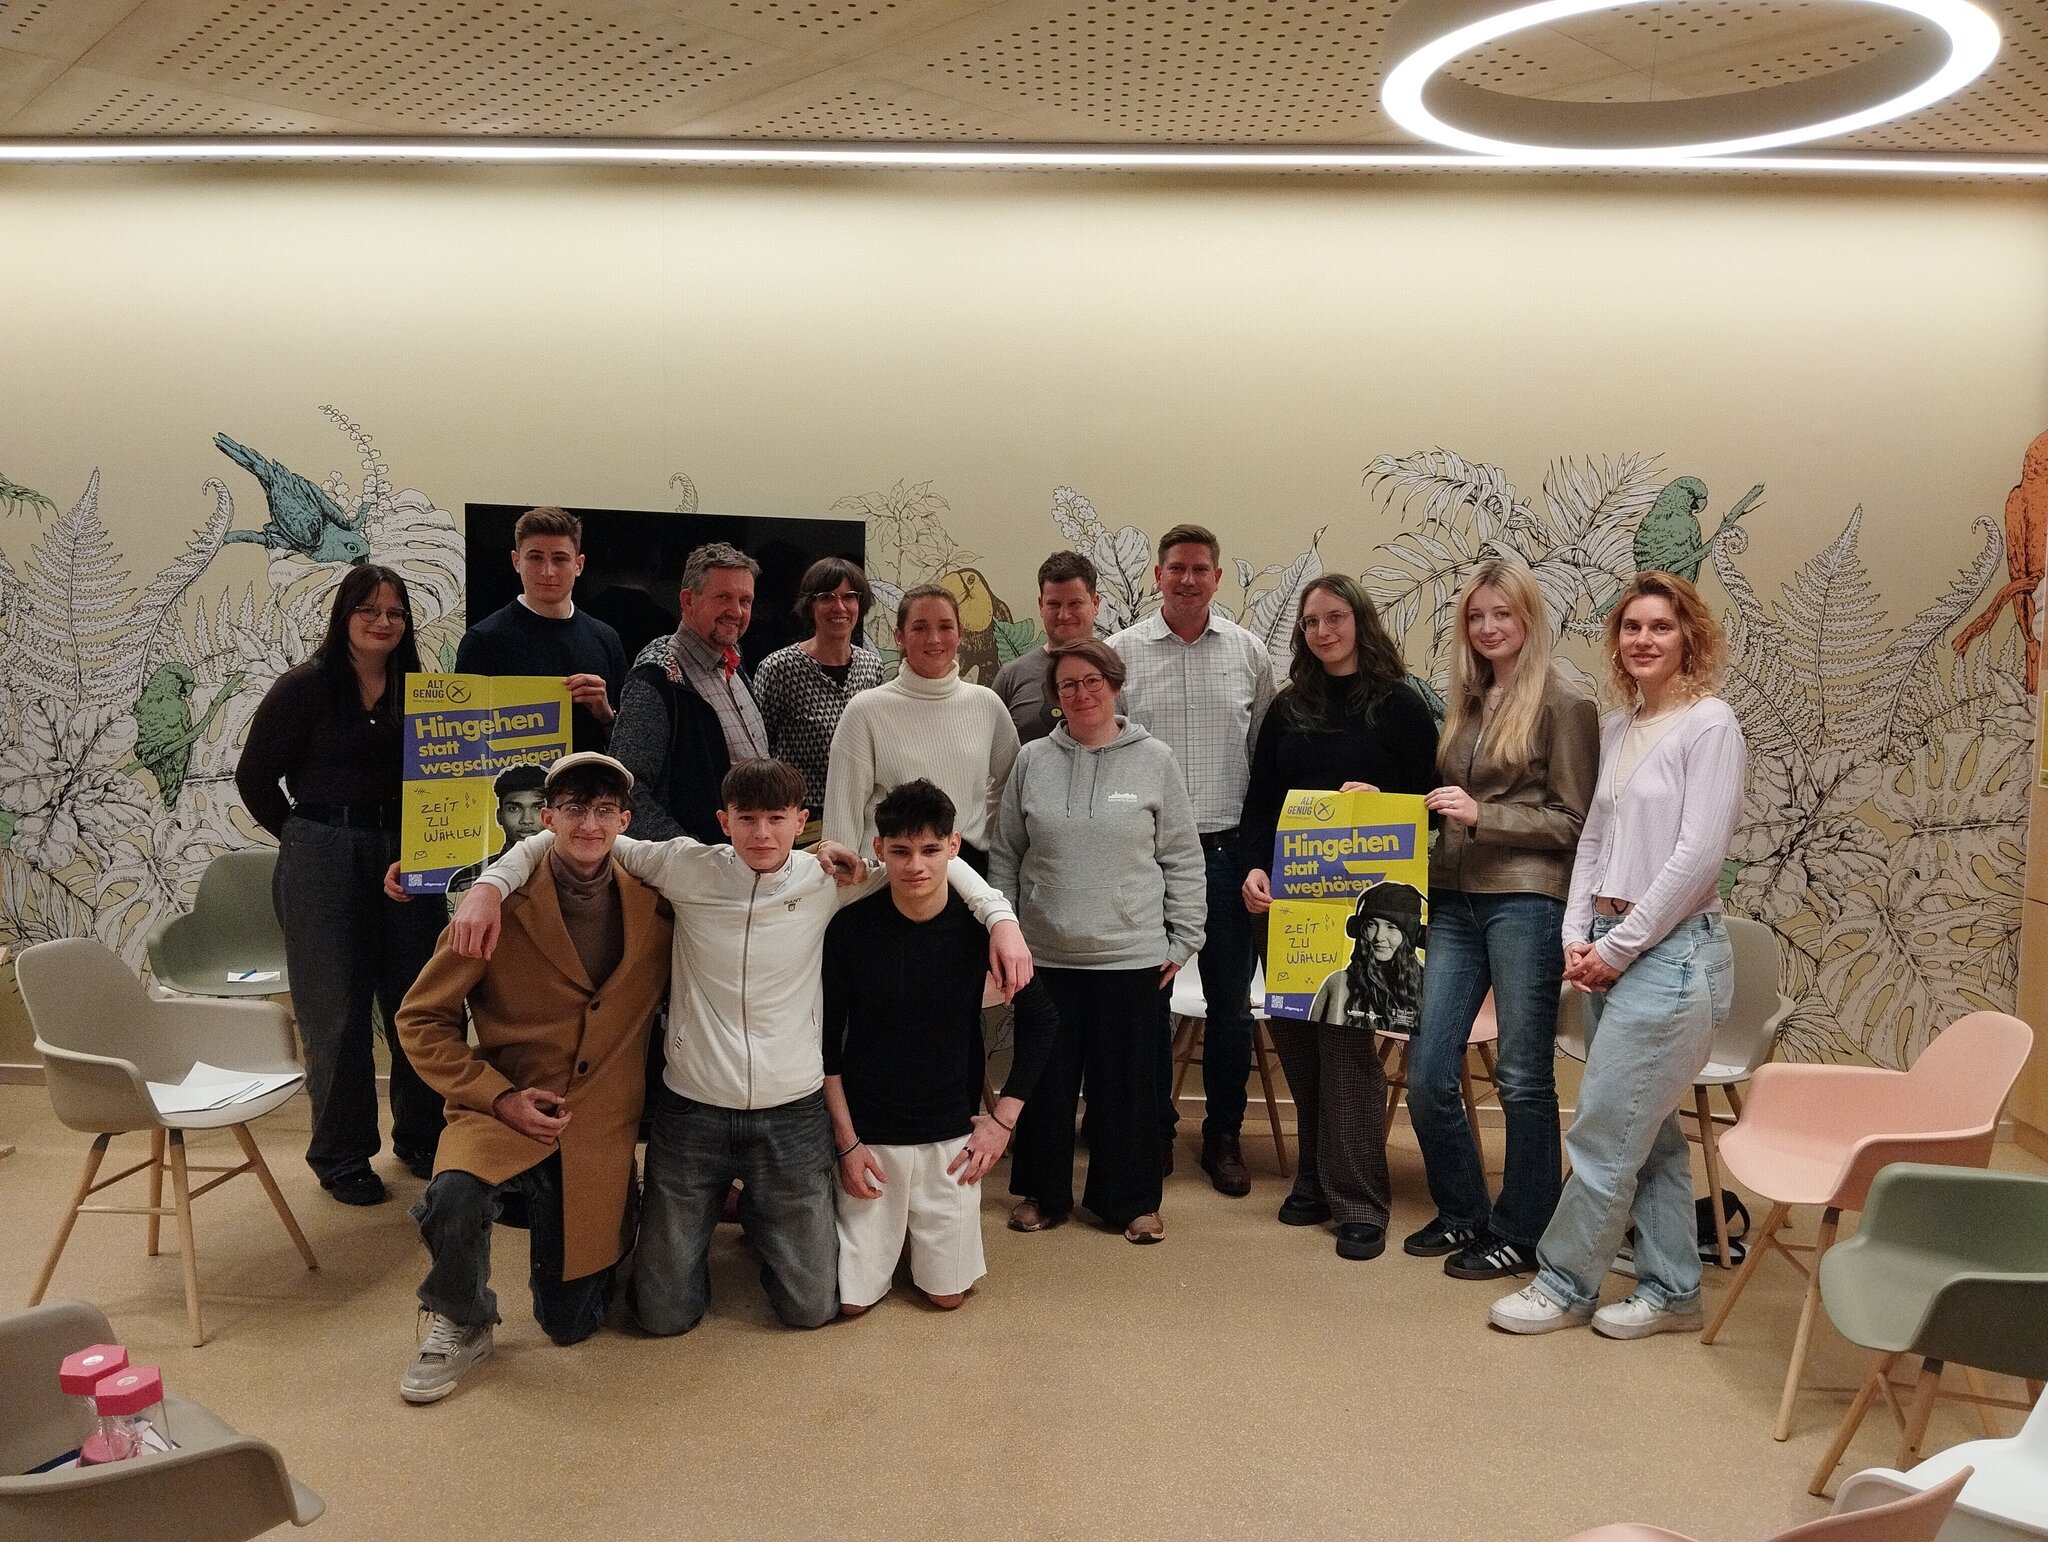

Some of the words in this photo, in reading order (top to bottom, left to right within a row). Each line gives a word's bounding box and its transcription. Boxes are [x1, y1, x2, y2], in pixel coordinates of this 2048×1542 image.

[427, 679, 445, 689] ALT
[413, 688, 445, 699] GENUG
[414, 710, 545, 742] Hingehen
[418, 740, 460, 757] statt
[420, 748, 562, 776] wegschweigen
[420, 797, 460, 813] ZEIT
[1300, 796, 1316, 806] ALT
[1287, 805, 1313, 816] GENUG
[425, 815, 449, 828] ZU
[423, 825, 482, 843] WÄHLEN
[1283, 828, 1400, 862] Hingehen
[1283, 860, 1319, 876] statt
[1283, 875, 1374, 898] weghören
[1284, 918, 1320, 934] ZEIT
[1288, 937, 1310, 949] ZU
[1286, 950, 1338, 965] WÄHLEN
